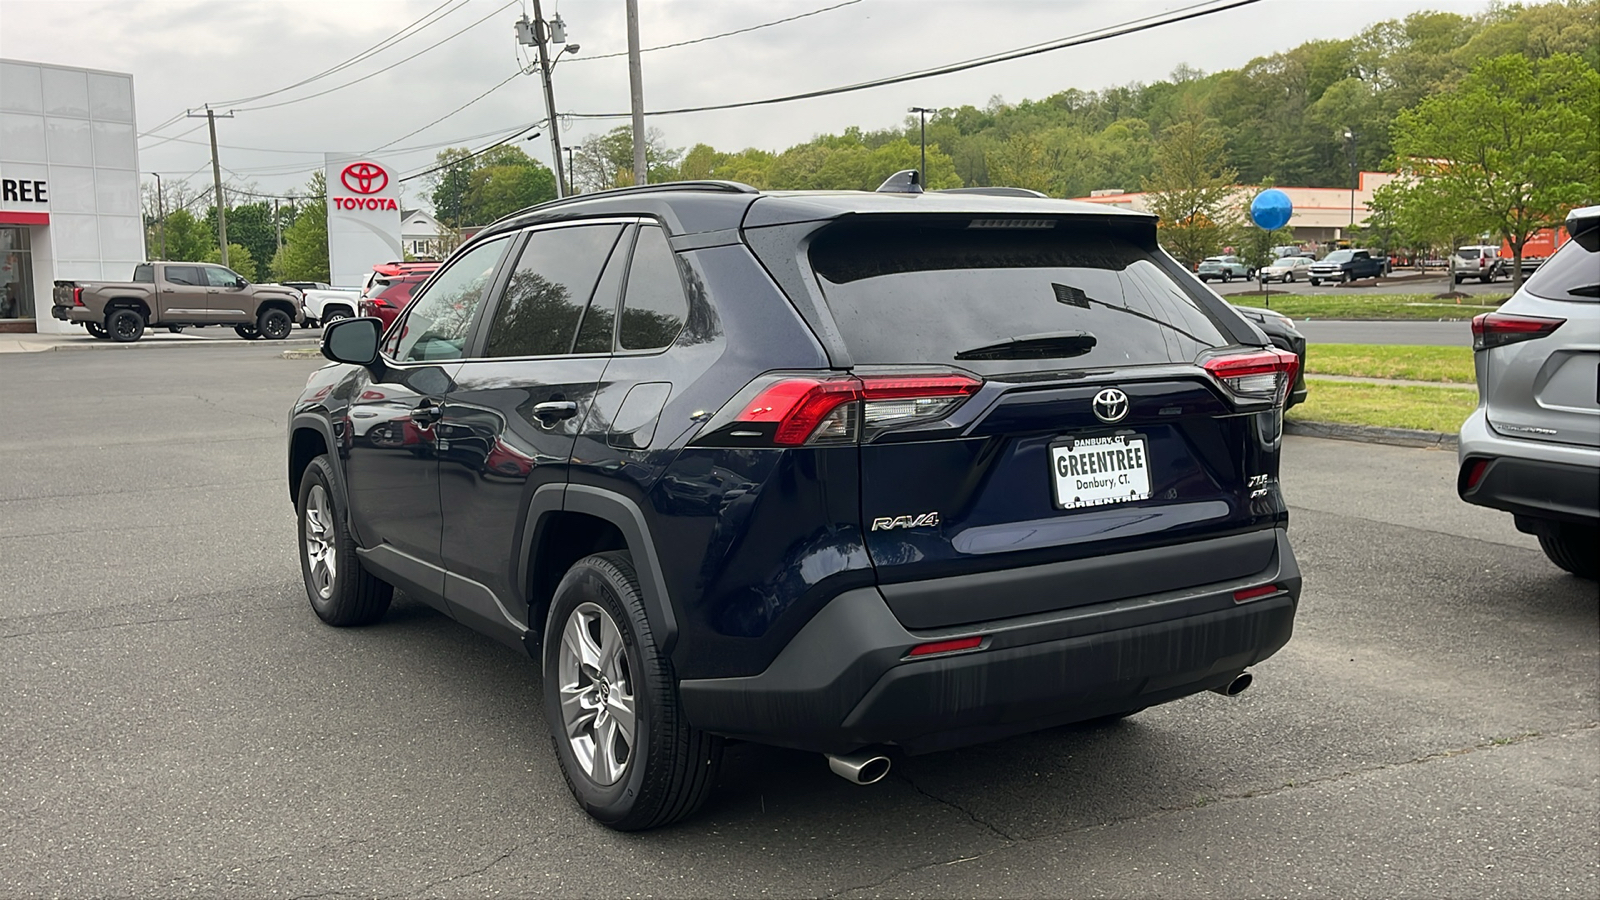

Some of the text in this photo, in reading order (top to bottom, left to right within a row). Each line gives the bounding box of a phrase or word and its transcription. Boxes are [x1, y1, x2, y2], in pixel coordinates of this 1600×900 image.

[2, 179, 48, 202] REE
[333, 197, 398, 211] TOYOTA
[1057, 447, 1143, 478] GREENTREE
[1076, 474, 1131, 490] Danbury, CT.
[871, 512, 939, 531] RAV4
